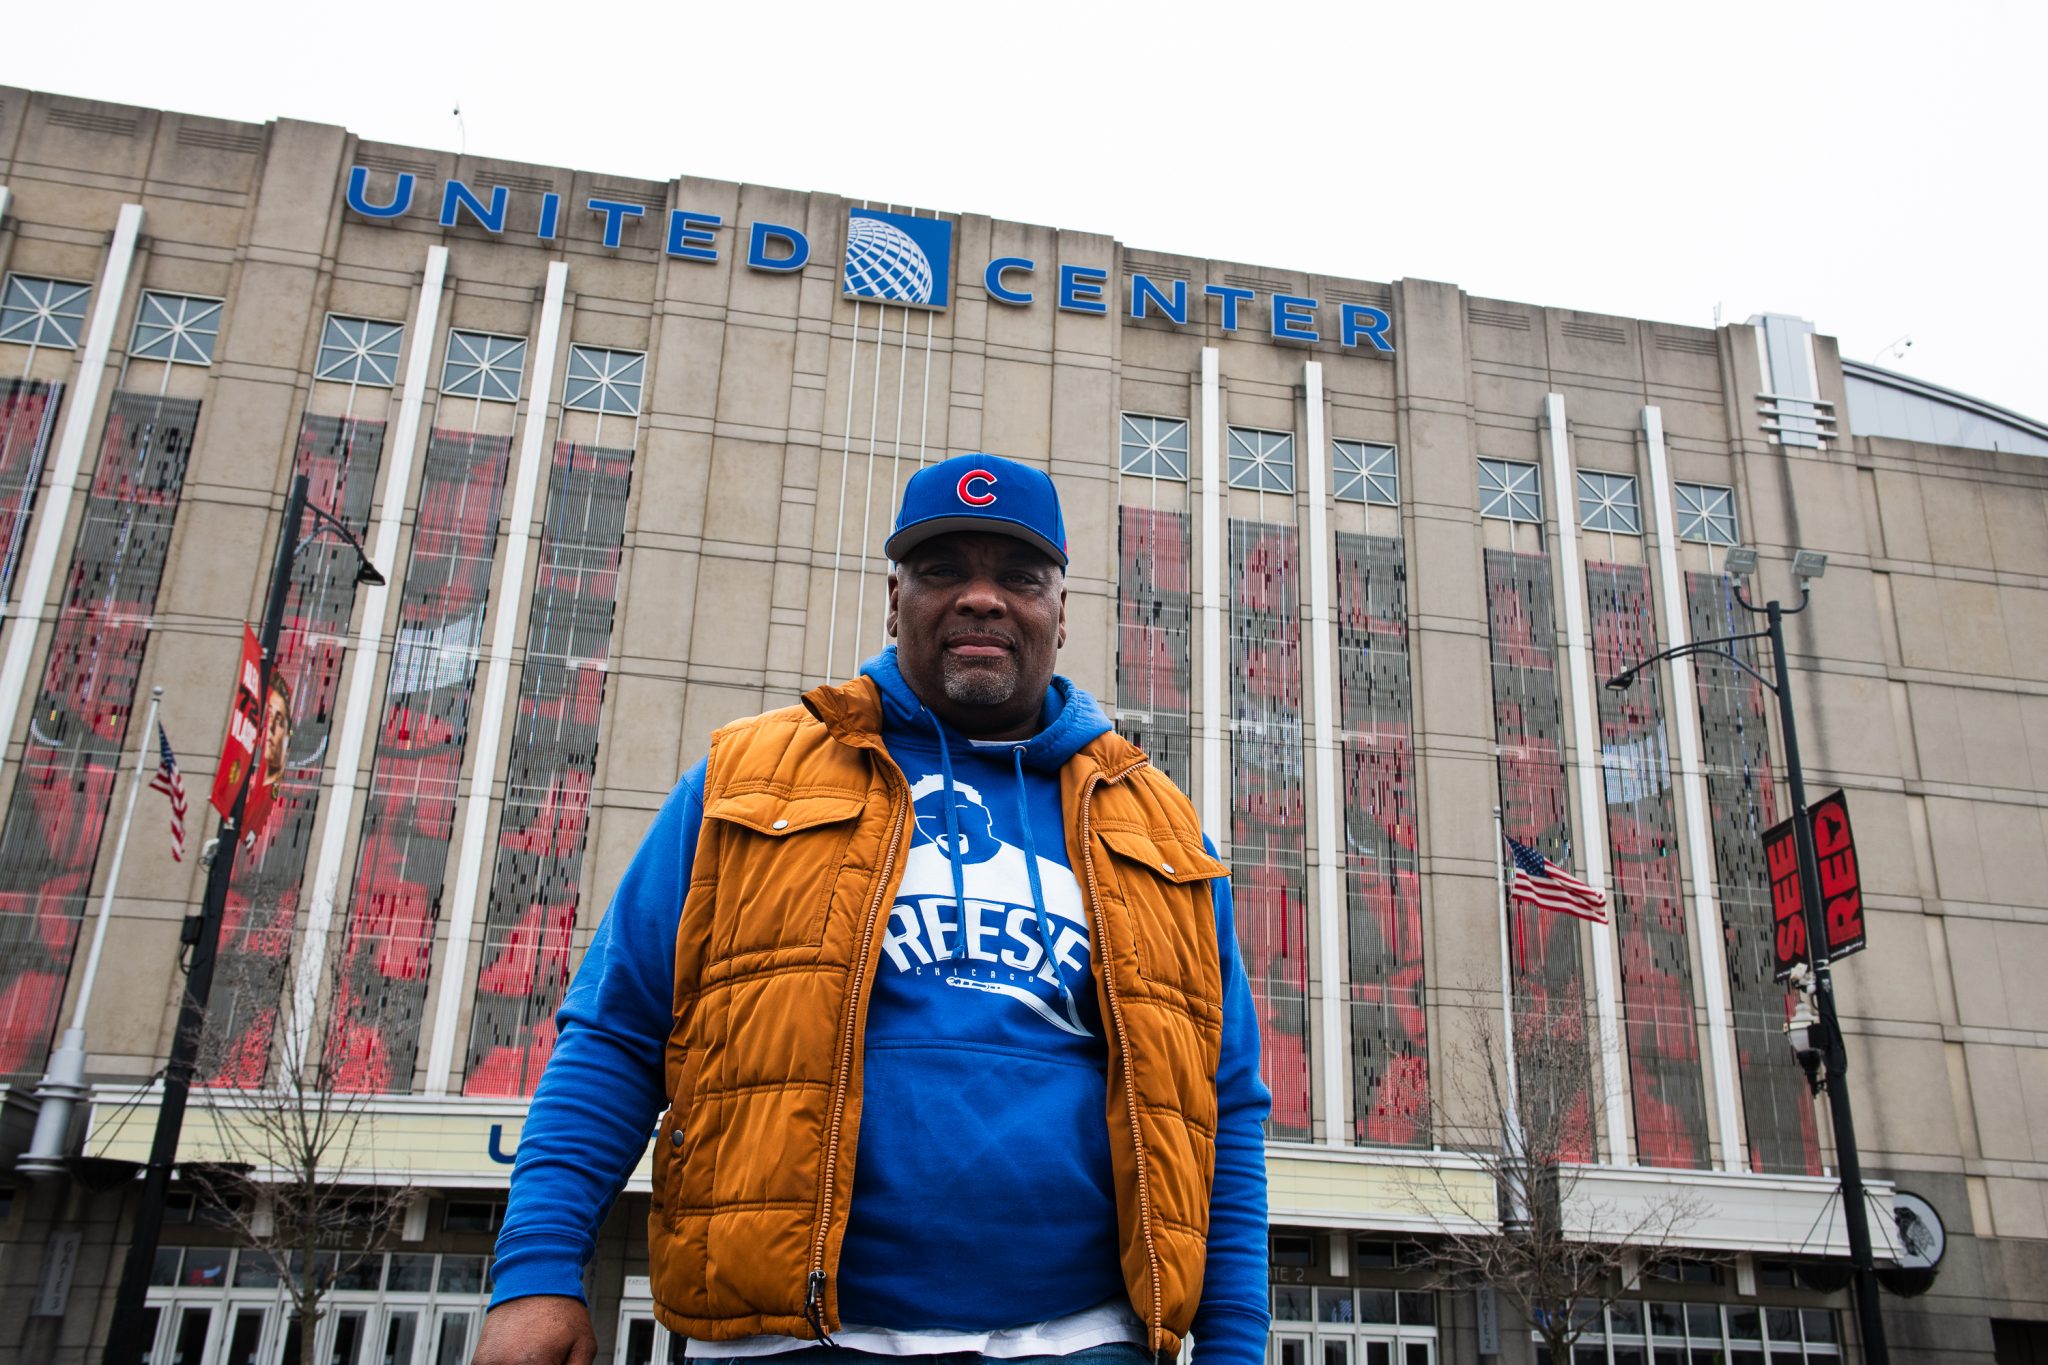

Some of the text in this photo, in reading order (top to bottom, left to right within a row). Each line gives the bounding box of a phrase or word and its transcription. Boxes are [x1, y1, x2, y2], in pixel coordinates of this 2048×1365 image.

[346, 165, 1396, 353] UNITED CENTER
[956, 469, 998, 508] C
[1767, 833, 1806, 962] SEE
[1814, 801, 1863, 947] RED
[916, 966, 1034, 983] CHICAGO
[1295, 1267, 1305, 1282] 2
